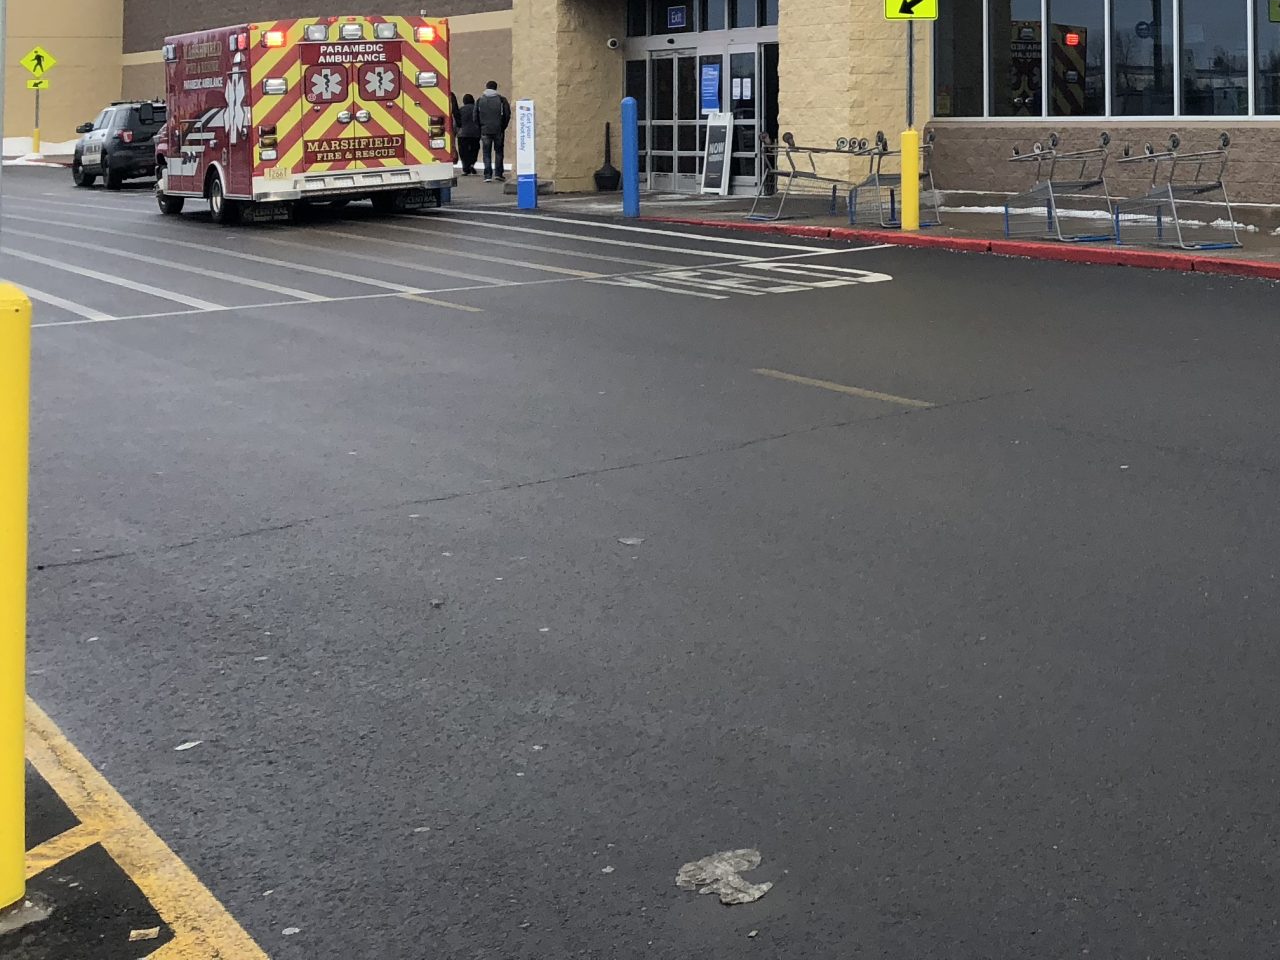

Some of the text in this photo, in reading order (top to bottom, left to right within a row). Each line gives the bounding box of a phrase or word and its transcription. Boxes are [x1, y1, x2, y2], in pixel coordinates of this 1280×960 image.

[320, 43, 384, 54] PARAMEDIC
[318, 53, 387, 64] AMBULANCE
[306, 136, 402, 152] MARSHFIELD
[316, 148, 396, 161] FIRE & RESCUE
[583, 262, 893, 300] YIELD
